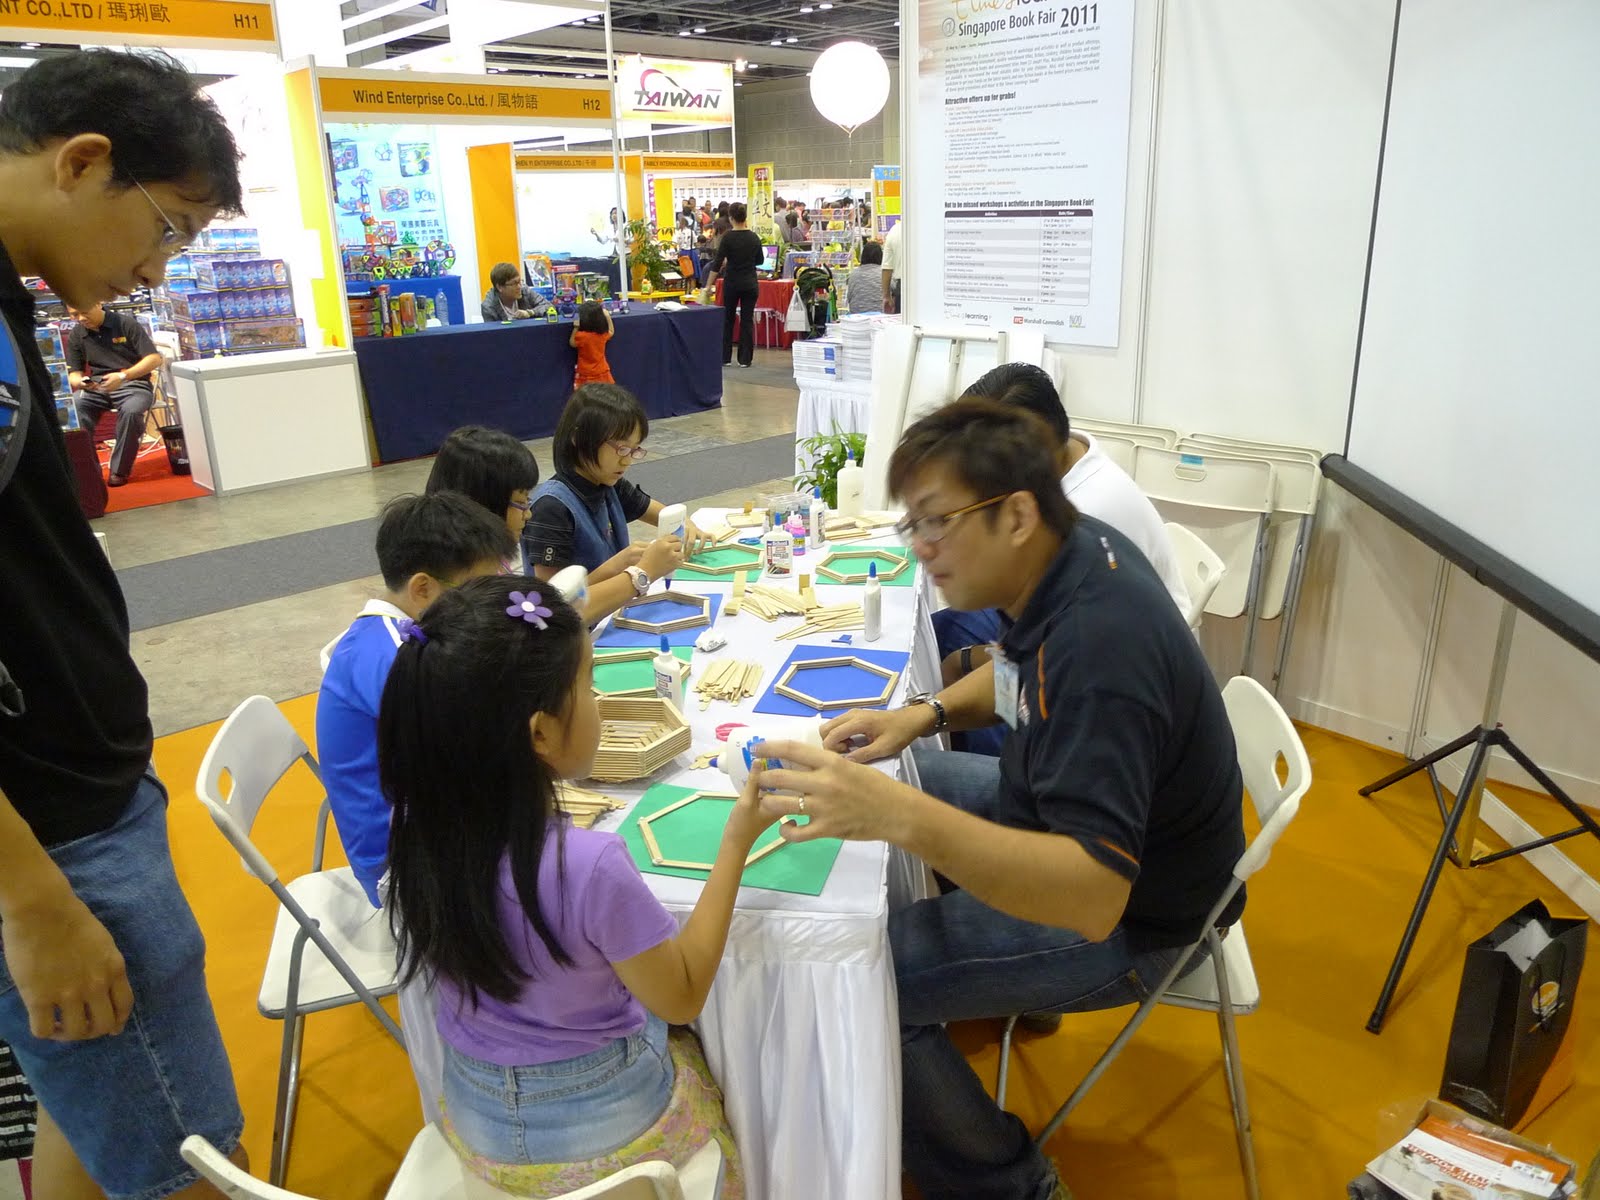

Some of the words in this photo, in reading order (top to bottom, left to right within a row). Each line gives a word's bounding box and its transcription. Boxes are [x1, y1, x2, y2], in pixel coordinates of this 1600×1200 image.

[233, 13, 259, 29] H11
[958, 19, 1006, 38] Singapore
[1009, 11, 1035, 29] Book
[1038, 8, 1057, 25] Fair
[1060, 3, 1098, 28] 2011
[353, 89, 384, 104] Wind
[386, 91, 444, 108] Enterprise
[497, 92, 539, 110] 風物語
[582, 98, 601, 111] H12
[634, 90, 720, 109] TAIWAN
[945, 97, 968, 105] Attractive
[969, 95, 983, 103] offers
[991, 93, 999, 101] for
[999, 91, 1016, 101] grabs!
[979, 200, 1003, 208] workshops
[1044, 199, 1069, 207] Singapore
[964, 312, 988, 322] learning
